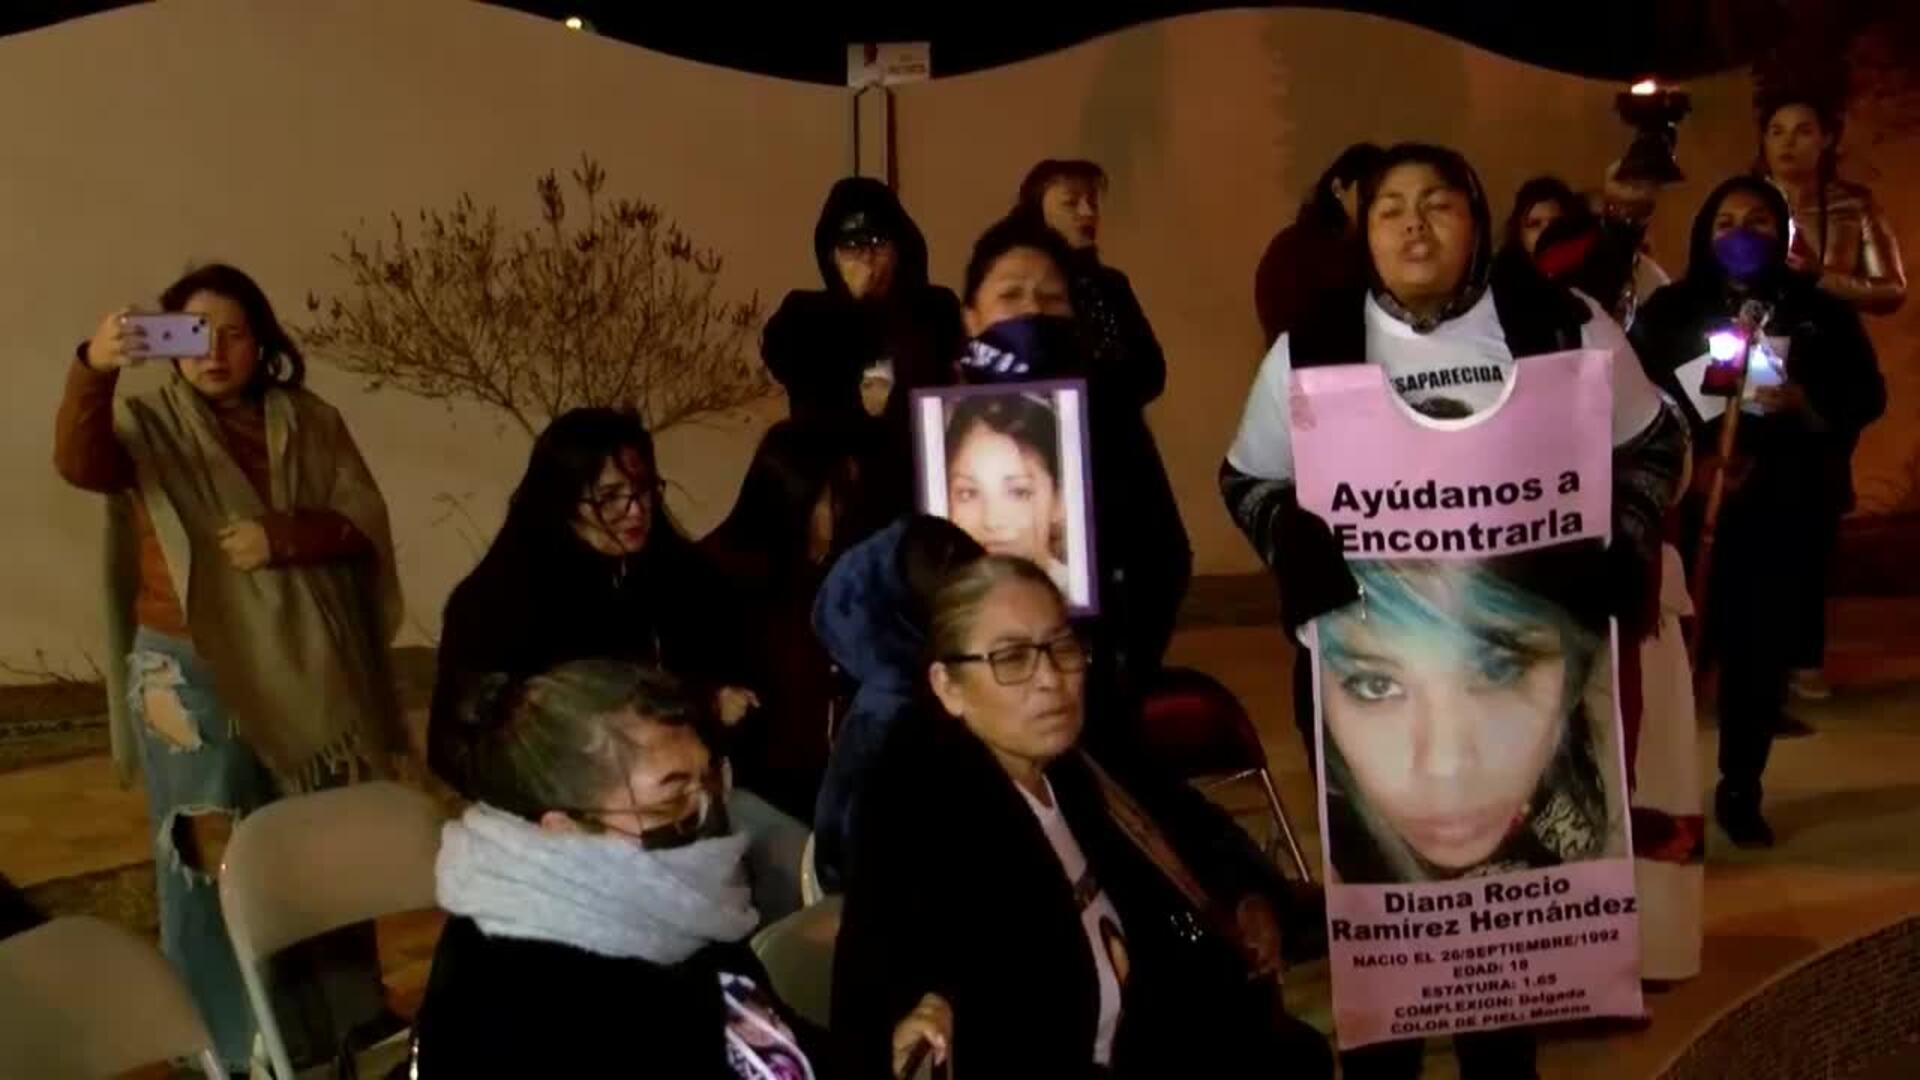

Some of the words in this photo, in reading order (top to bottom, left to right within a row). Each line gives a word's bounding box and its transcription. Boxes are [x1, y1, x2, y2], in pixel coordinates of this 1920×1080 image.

[1389, 364, 1505, 394] SAPARECIDA
[1331, 477, 1543, 518] Ayúdanos
[1558, 470, 1580, 494] a
[1334, 509, 1583, 552] Encontrarla
[1384, 889, 1473, 914] Diana
[1470, 895, 1638, 933] Hernández
[1414, 952, 1434, 963] EL
[1453, 963, 1503, 978] EDAD:
[1422, 980, 1516, 998] ESTATURA:
[1524, 974, 1557, 987] 1.65
[1519, 989, 1586, 1005] Delgada
[1391, 1020, 1449, 1034] COLOR
[1455, 1017, 1476, 1028] DE
[1483, 1012, 1525, 1027] PIEL:
